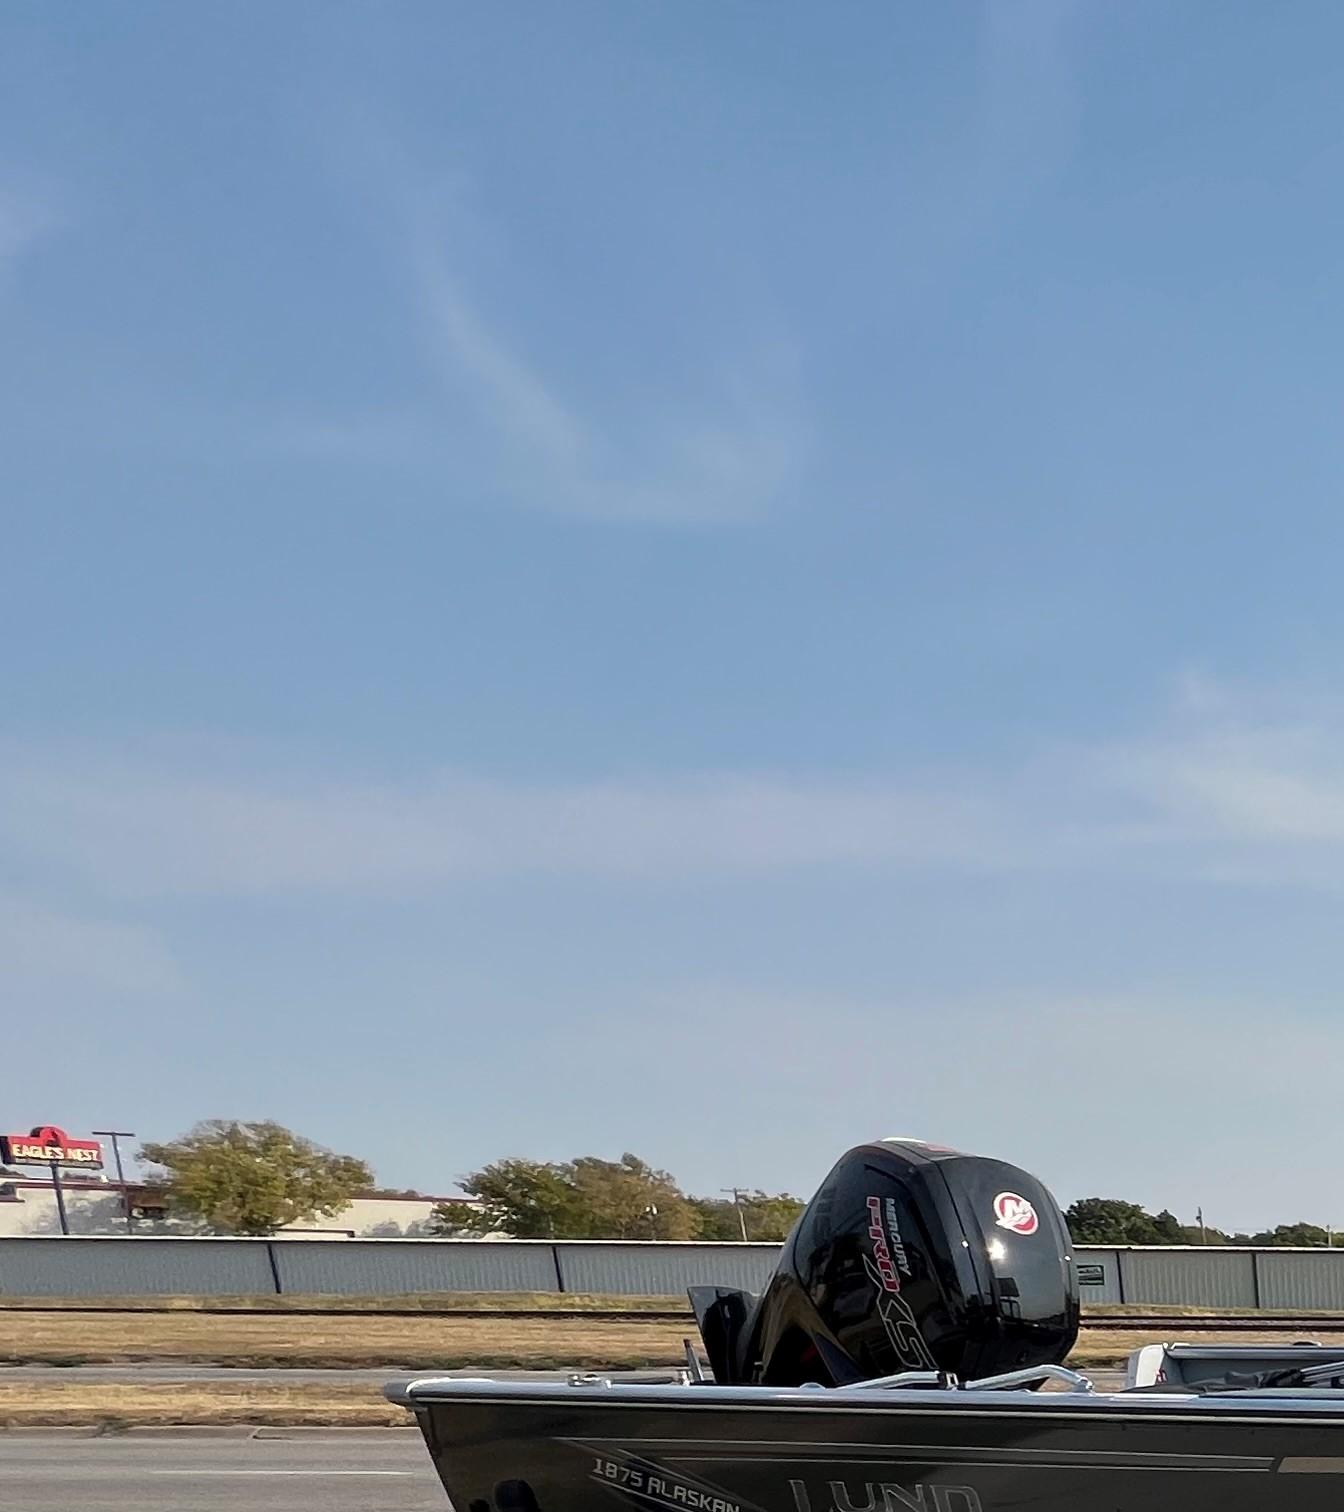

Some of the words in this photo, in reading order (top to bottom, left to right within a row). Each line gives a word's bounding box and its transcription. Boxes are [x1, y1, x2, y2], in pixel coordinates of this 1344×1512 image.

[12, 1143, 65, 1160] EAGLE'S
[67, 1148, 99, 1162] NEST
[866, 1196, 901, 1293] PRO
[885, 1197, 912, 1276] MERCURY
[592, 1458, 643, 1488] 1875
